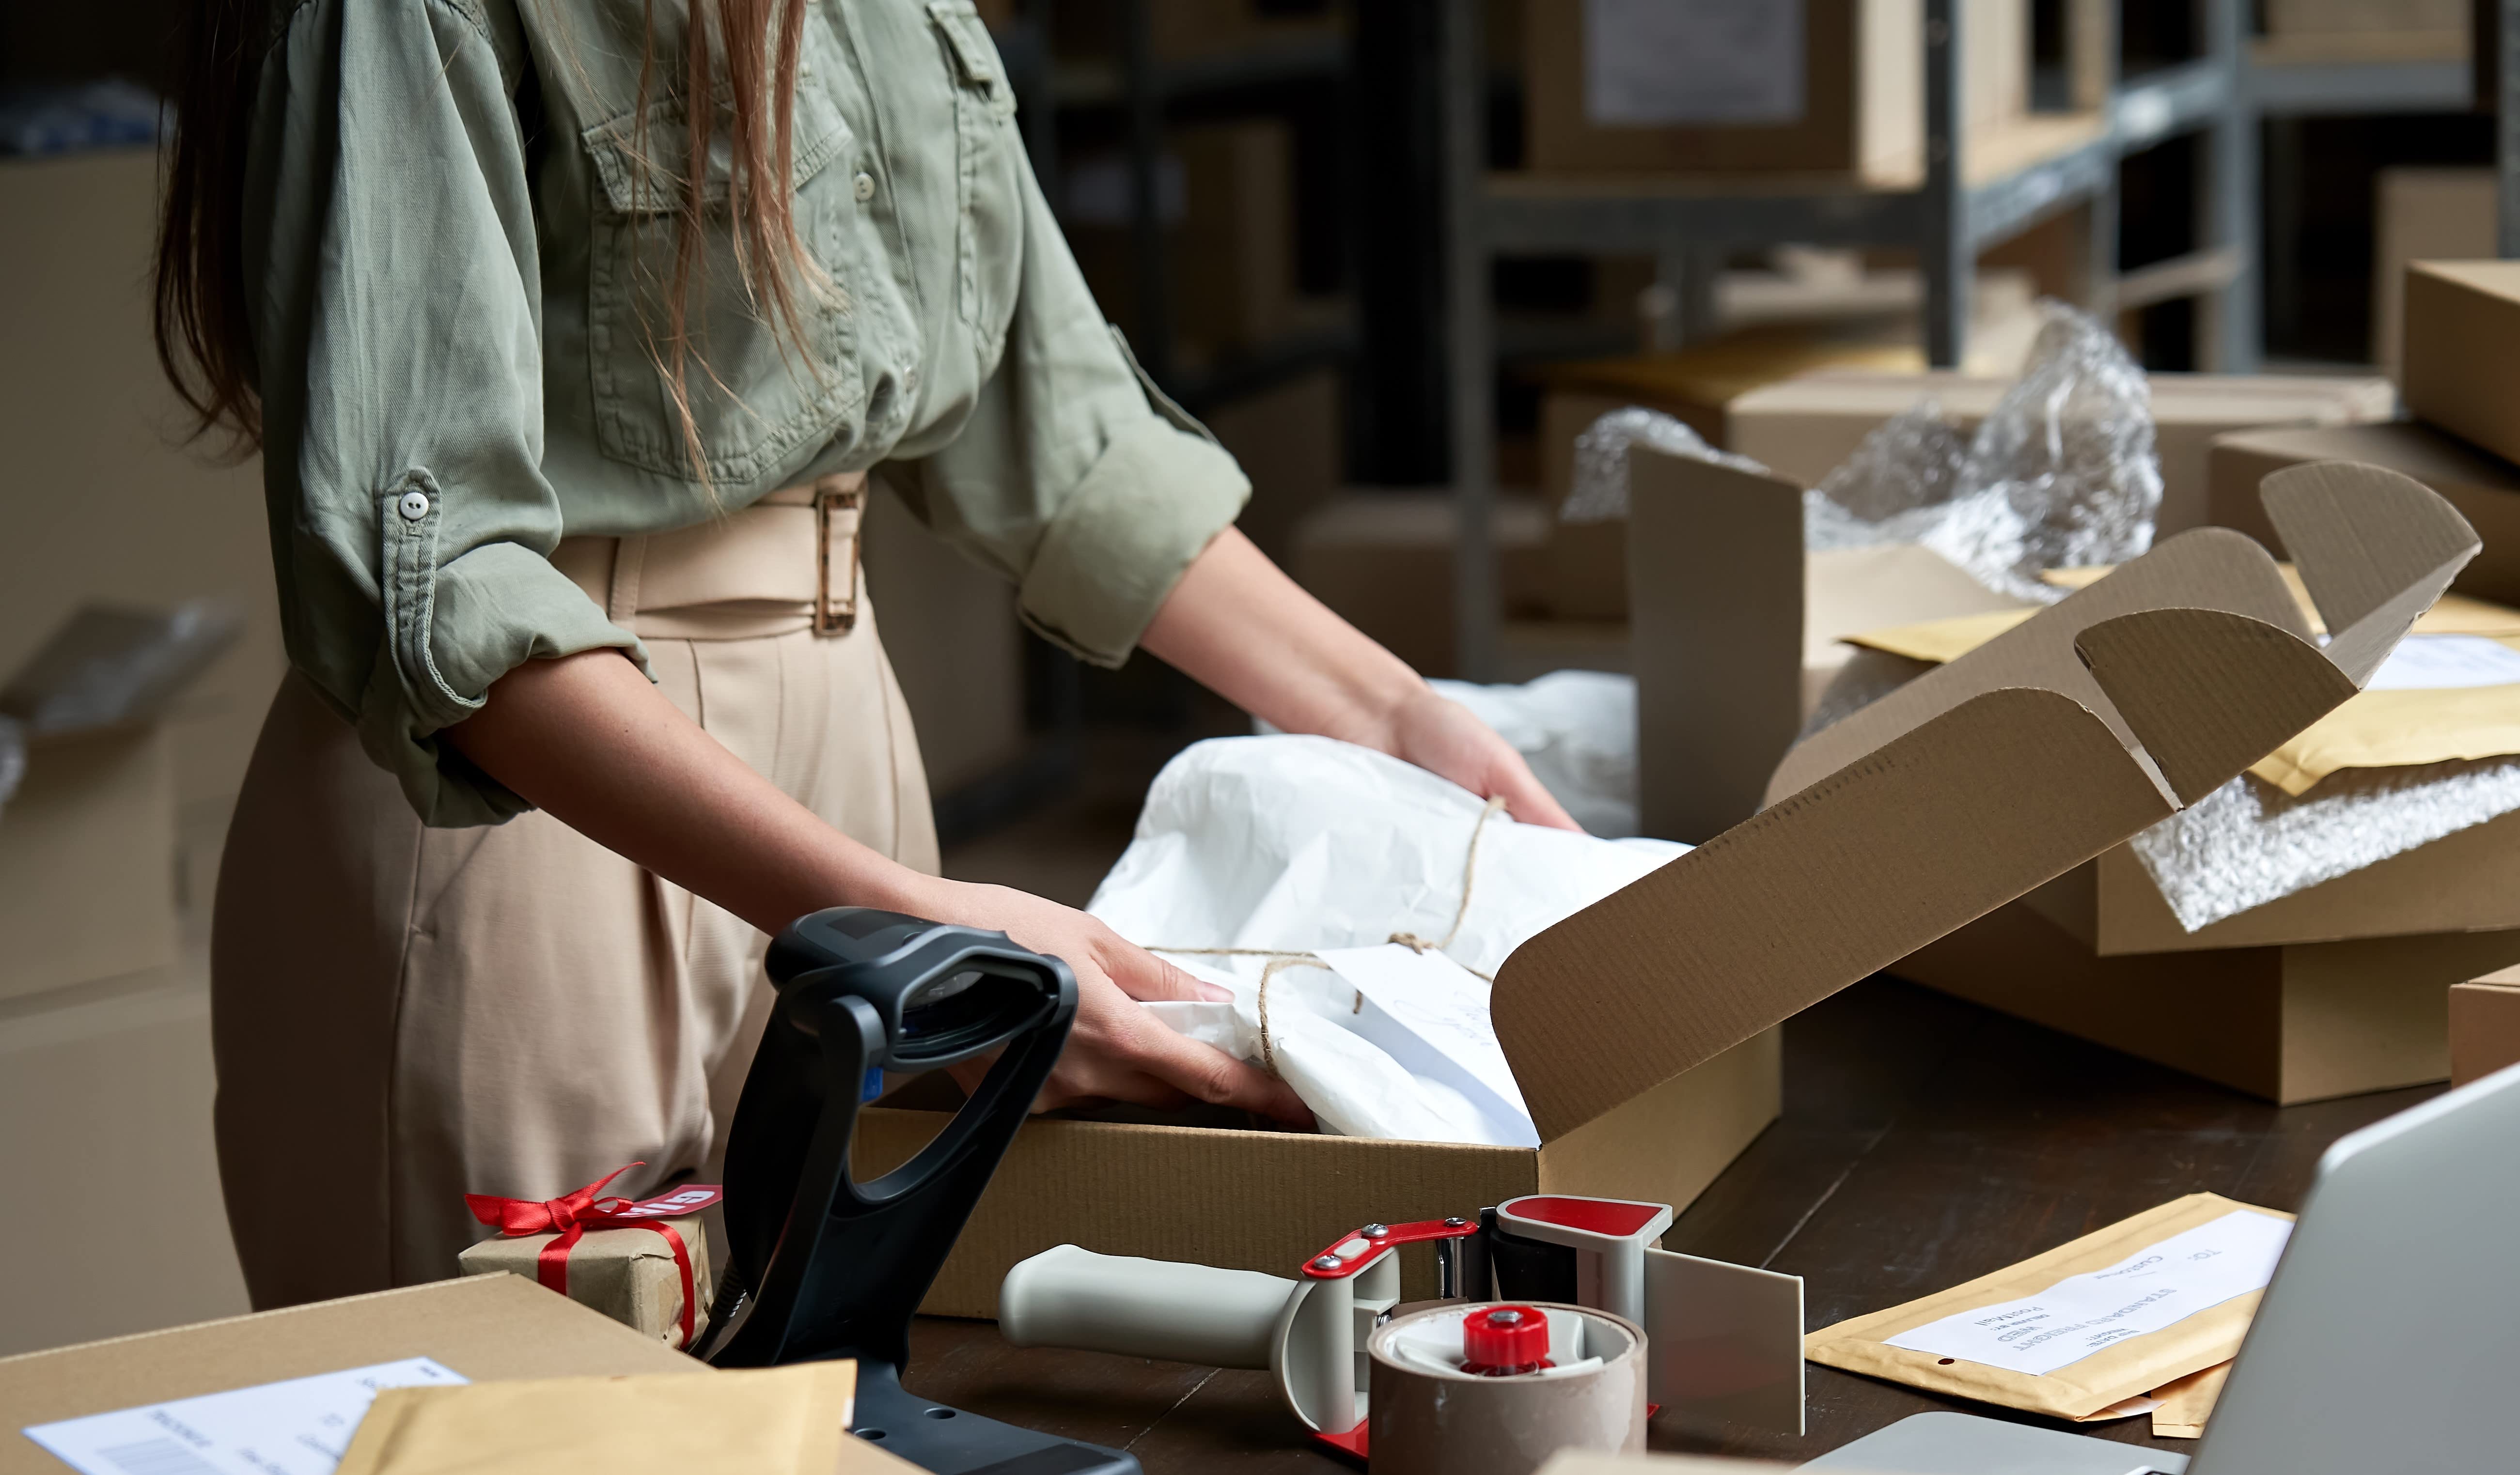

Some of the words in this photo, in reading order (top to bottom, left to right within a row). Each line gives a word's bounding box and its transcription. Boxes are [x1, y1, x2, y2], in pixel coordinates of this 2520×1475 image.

[2085, 1289, 2176, 1325] STANDARD
[1974, 1307, 2044, 1326] PostMail
[2008, 1314, 2050, 1326] DELIVER
[1998, 1326, 2042, 1342] WED
[2013, 1323, 2088, 1351] FREIGHT
[2086, 1335, 2115, 1347] DATE:
